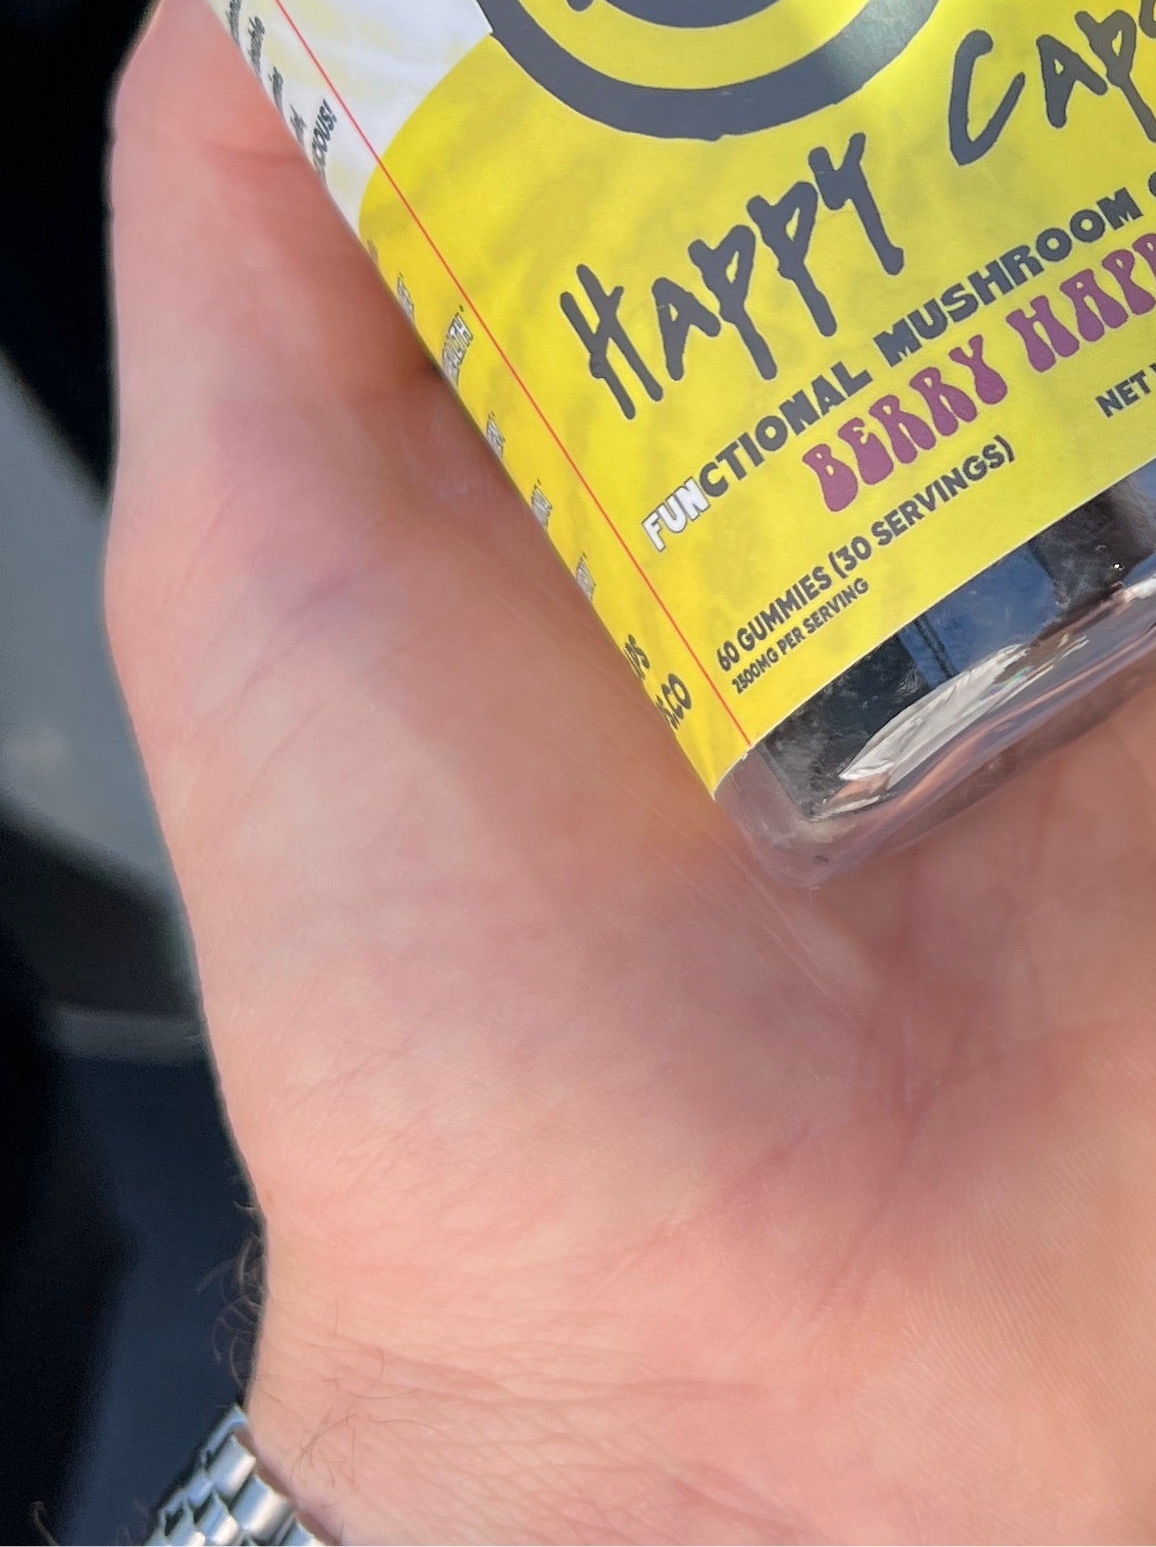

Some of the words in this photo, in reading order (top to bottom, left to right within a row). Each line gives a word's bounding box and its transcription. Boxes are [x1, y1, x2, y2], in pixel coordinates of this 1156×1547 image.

[640, 360, 874, 553] FUNCTIONAL
[873, 186, 1144, 368] MUSHROOM
[802, 334, 1008, 512] BERRY
[1095, 369, 1152, 418] NET
[716, 640, 740, 672] 60
[736, 566, 832, 652] GUMMIES
[828, 535, 872, 579] (30
[871, 434, 1016, 547] SERVINGS)
[778, 626, 807, 656] PER
[803, 577, 870, 635] SERVING
